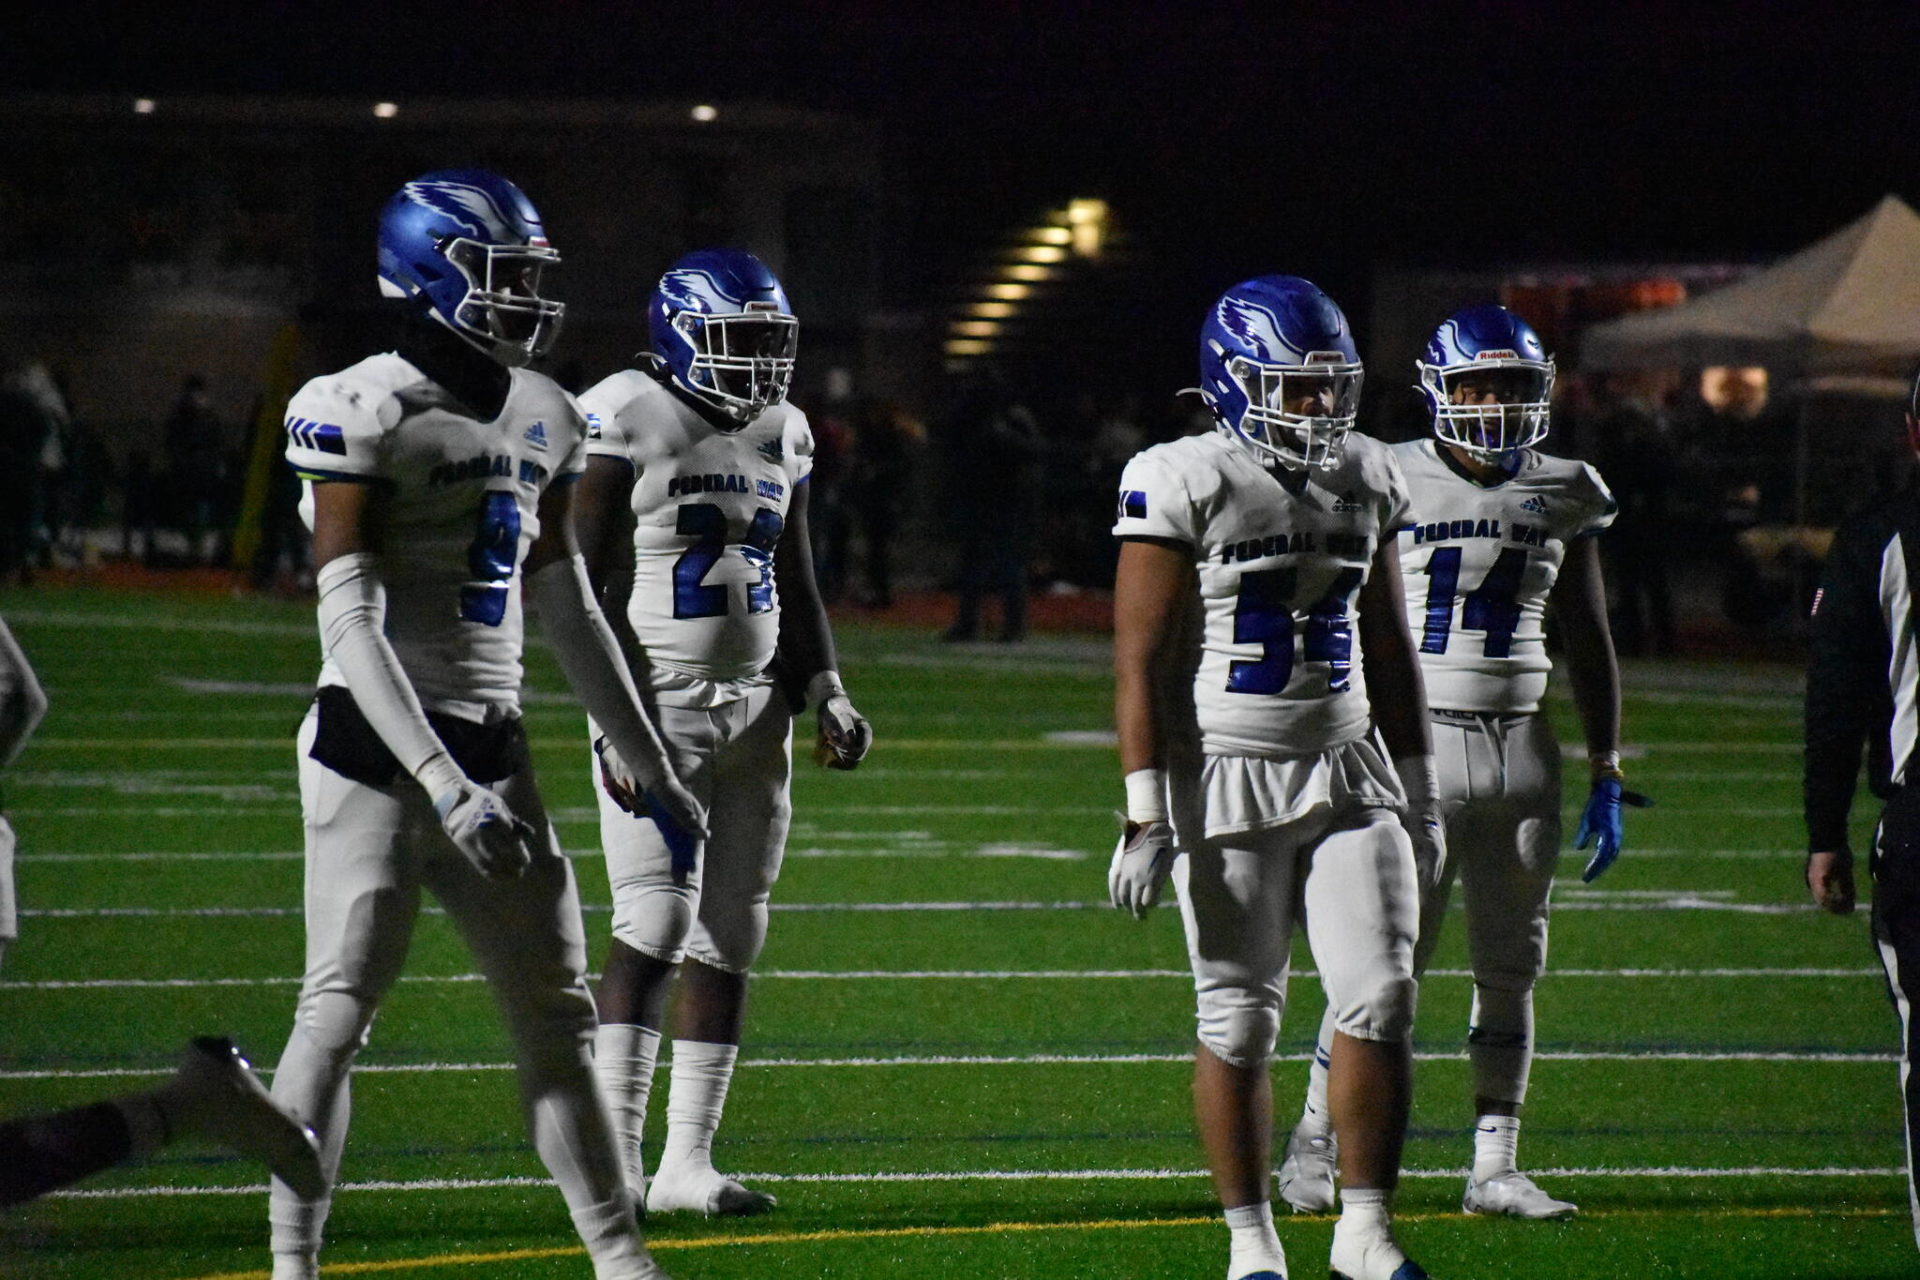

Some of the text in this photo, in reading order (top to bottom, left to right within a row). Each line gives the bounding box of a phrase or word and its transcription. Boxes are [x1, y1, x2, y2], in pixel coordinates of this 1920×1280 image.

[668, 474, 748, 497] FEDERAL
[1414, 519, 1500, 544] FEDERAL
[1222, 532, 1315, 564] FEDERAL
[1419, 546, 1528, 658] 14
[1225, 566, 1364, 695] 54
